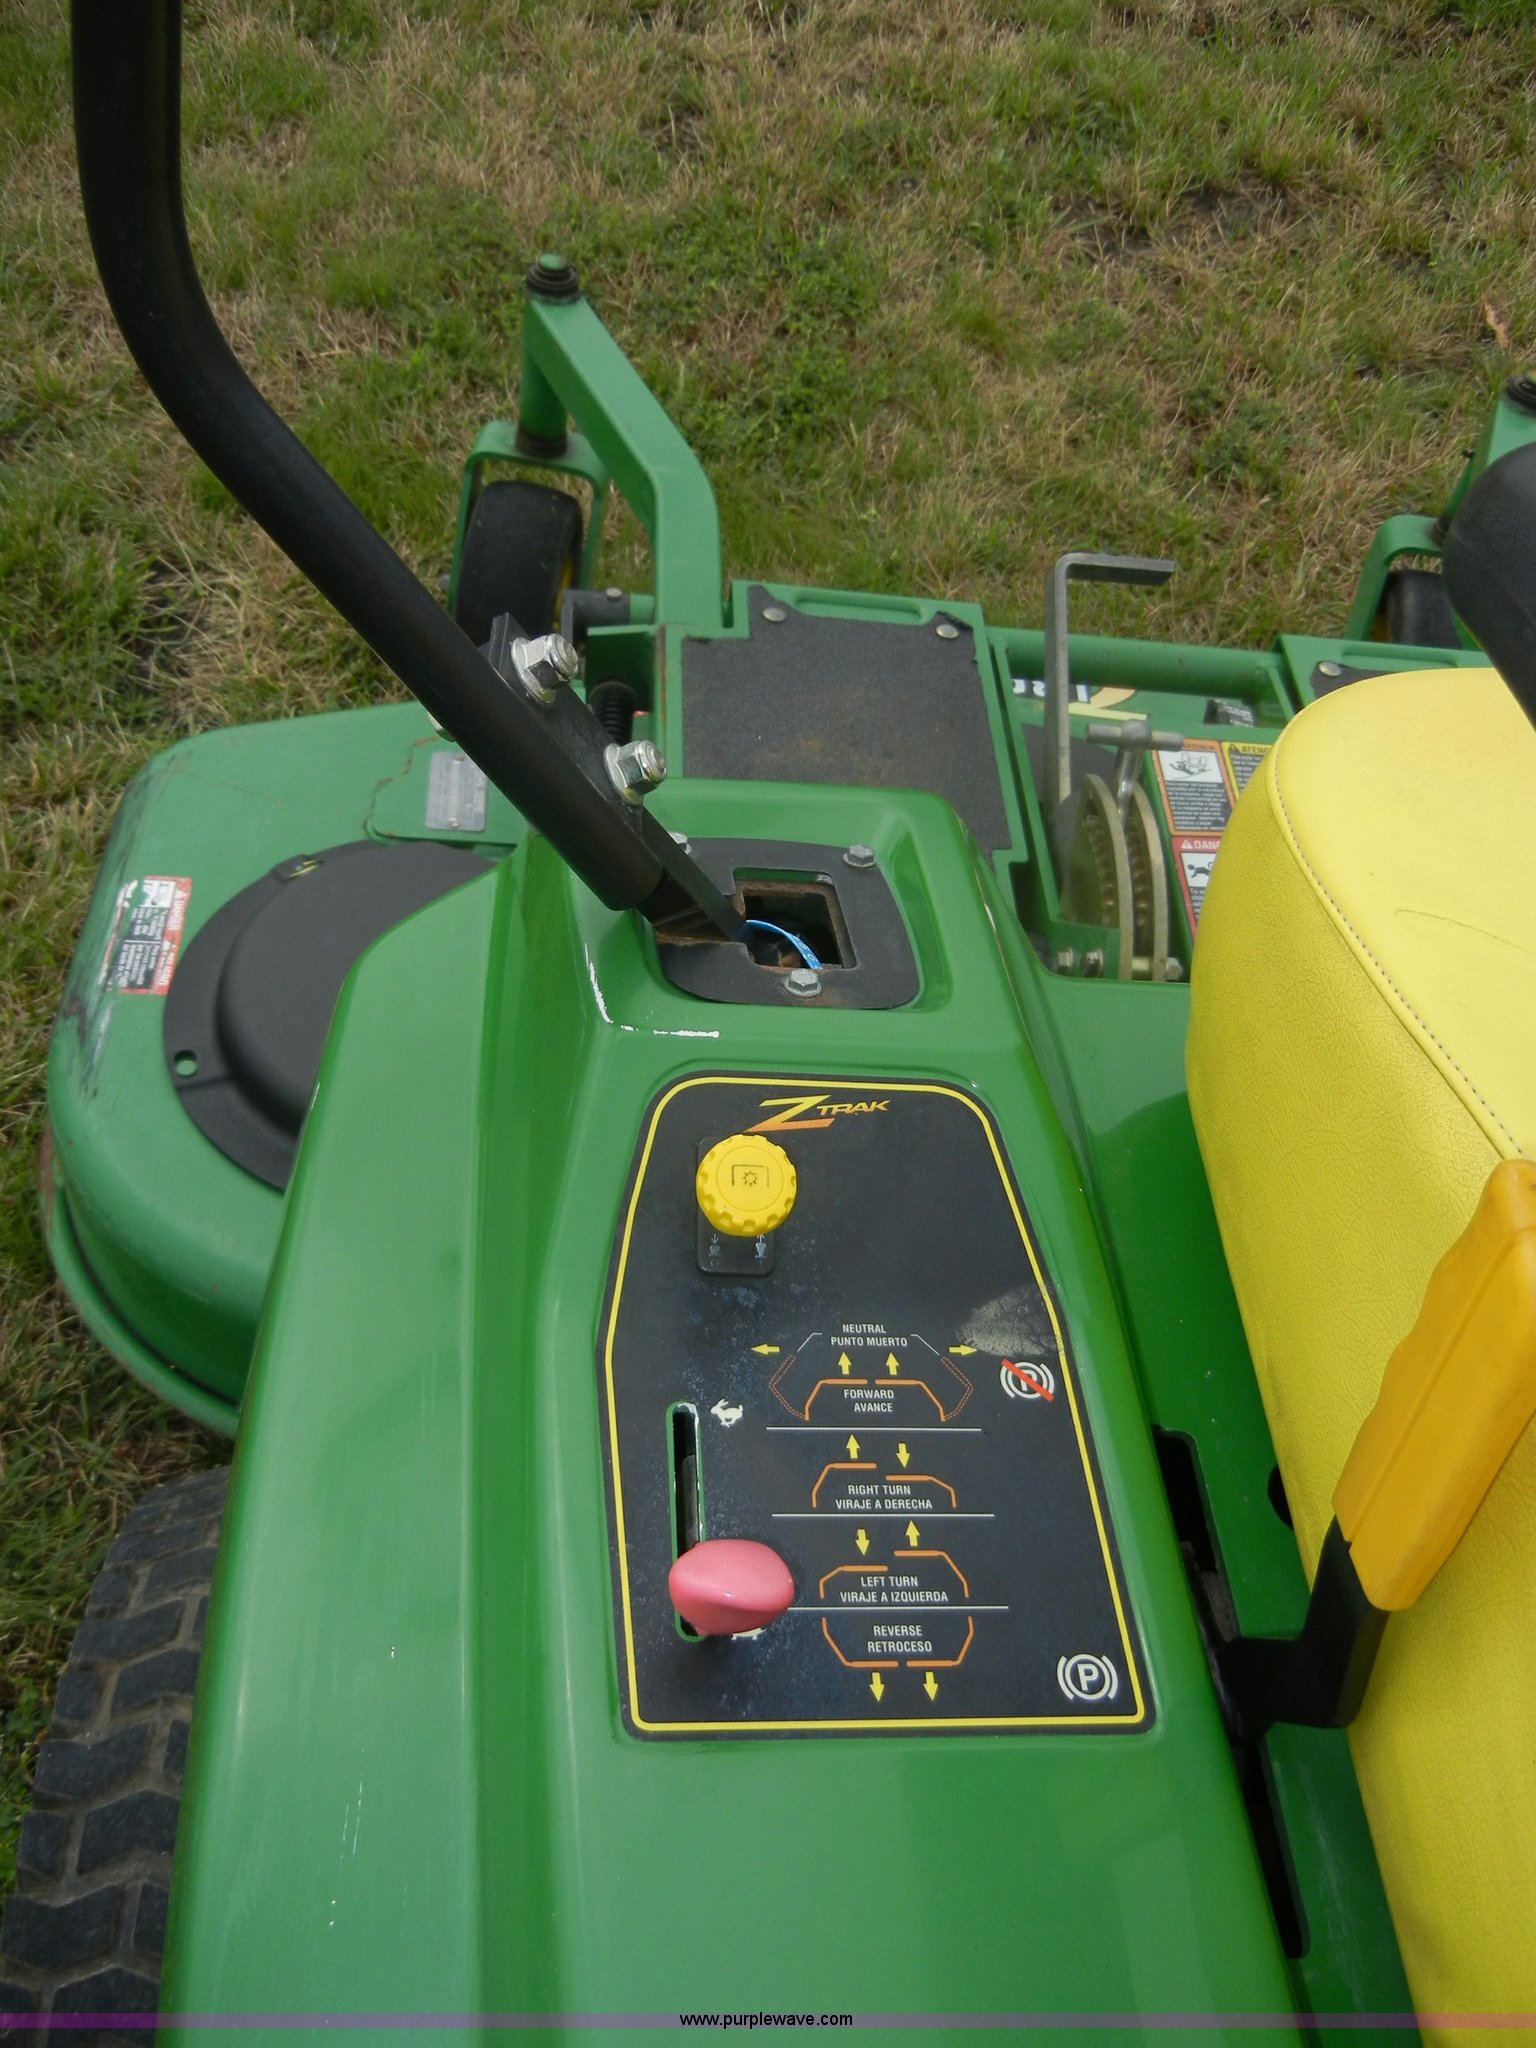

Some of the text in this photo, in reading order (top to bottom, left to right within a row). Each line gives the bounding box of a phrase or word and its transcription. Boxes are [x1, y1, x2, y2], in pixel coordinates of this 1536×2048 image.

[1193, 840, 1220, 849] DANG
[842, 1323, 887, 1334] NEUTRAL
[831, 1336, 908, 1347] PUNTO MUERTO
[844, 1389, 895, 1399] FORWARD
[854, 1402, 893, 1412] AVANCE
[848, 1485, 911, 1495] RIGHT TURN
[835, 1499, 933, 1509] VIRAJE A DERECHA
[860, 1576, 919, 1587] LEFT TURN
[840, 1591, 949, 1602] VIRAJE A IZQUIERDA
[873, 1625, 922, 1636] REVERSE
[867, 1640, 933, 1653] RETROCESO
